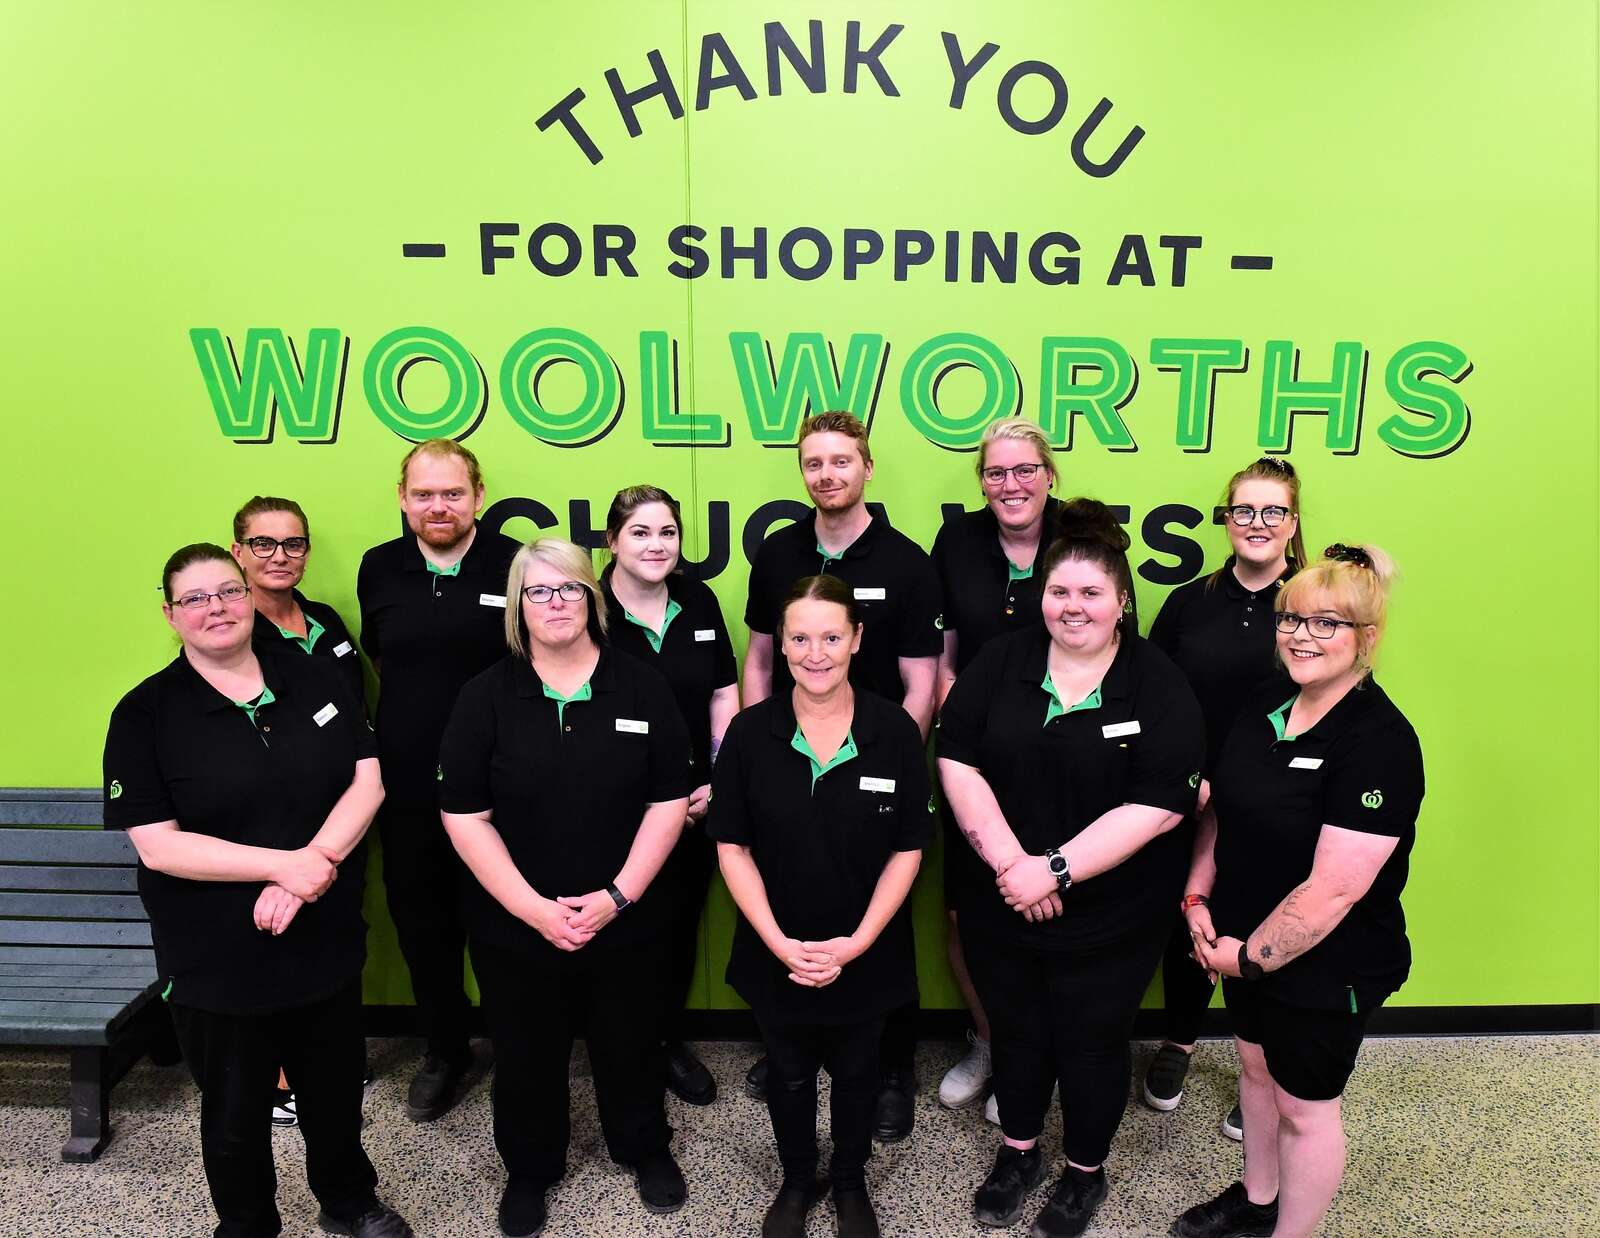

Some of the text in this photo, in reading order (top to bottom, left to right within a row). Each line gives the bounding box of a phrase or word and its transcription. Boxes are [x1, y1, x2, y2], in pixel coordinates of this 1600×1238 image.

[536, 20, 1145, 177] THANK YOU
[480, 223, 1202, 287] FOR SHOPPING AT
[189, 326, 1473, 459] WOOLWORTHS
